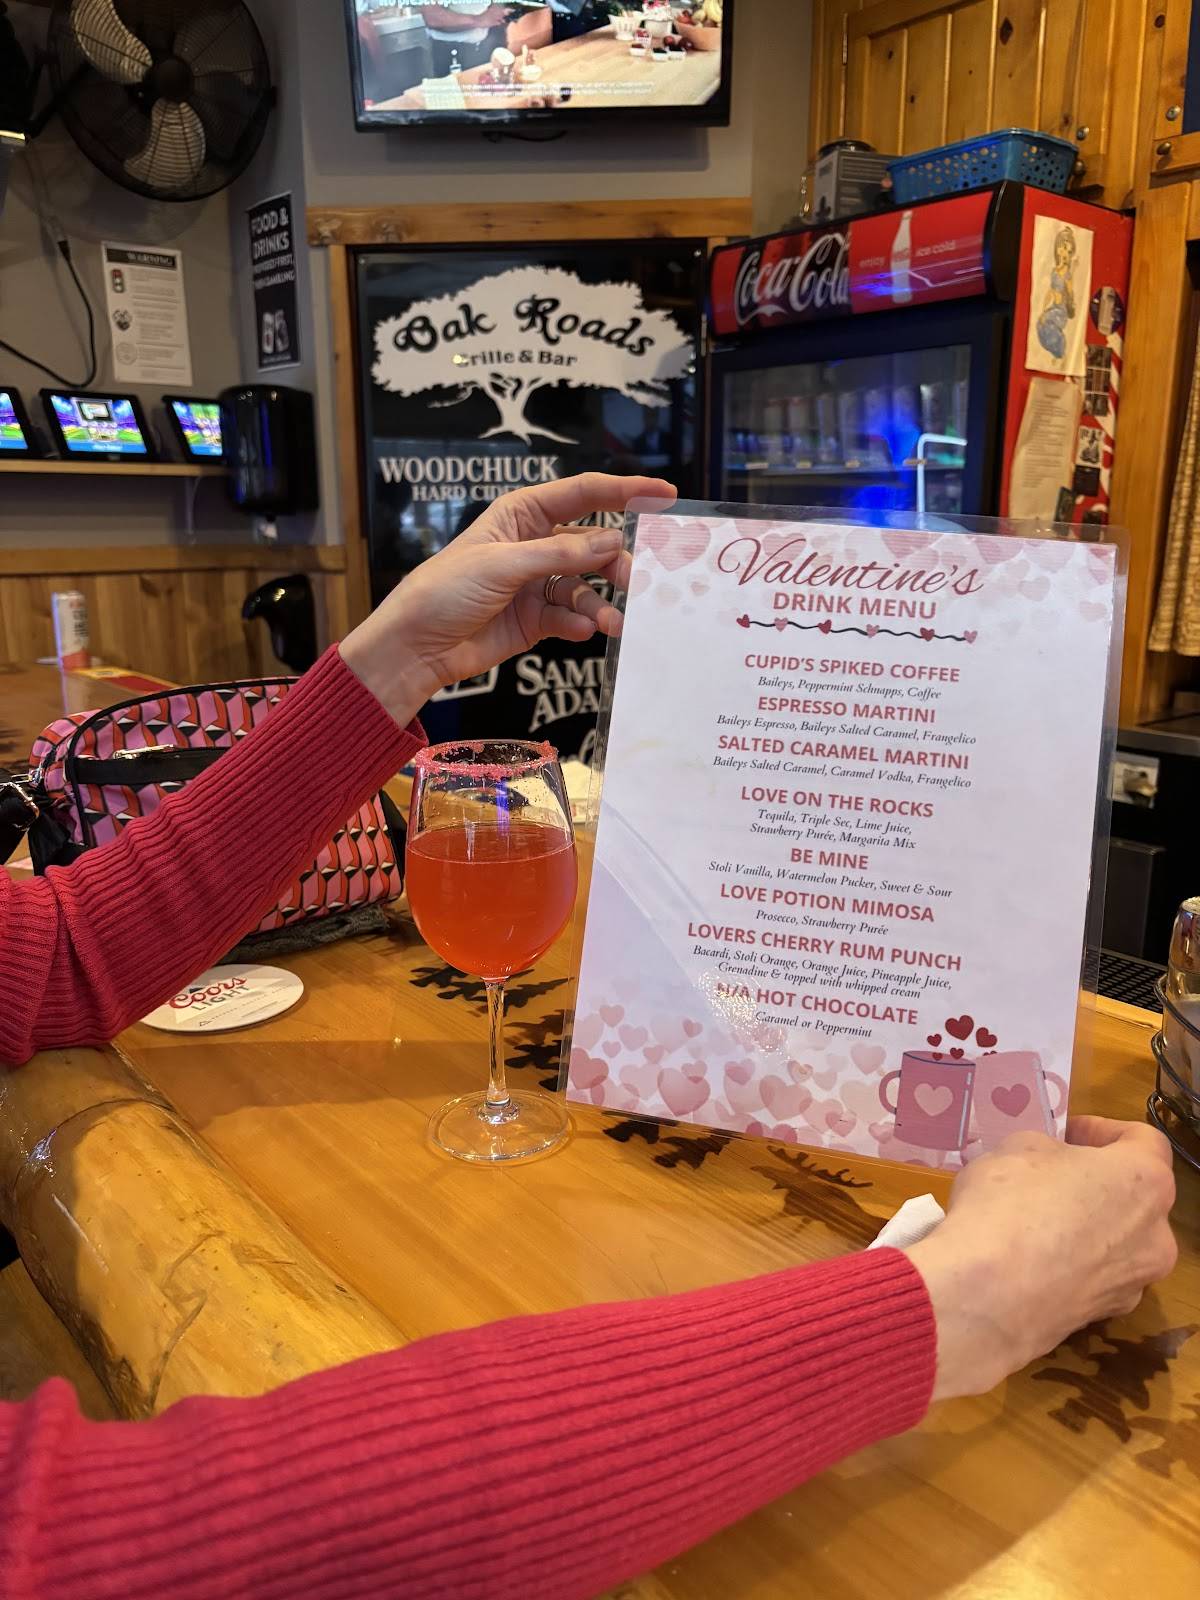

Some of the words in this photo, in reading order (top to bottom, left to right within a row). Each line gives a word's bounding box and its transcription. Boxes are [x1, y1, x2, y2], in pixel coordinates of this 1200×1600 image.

[251, 210, 278, 234] FOOD
[279, 207, 289, 226] &
[253, 231, 290, 259] DRINKS
[859, 256, 886, 269] enjoy
[932, 239, 956, 254] cold
[735, 232, 850, 326] Coca-Cola
[393, 303, 497, 352] Oak
[514, 294, 655, 356] Roads
[518, 349, 533, 364] &
[538, 350, 578, 367] Bar
[378, 456, 559, 484] WOODCHUCK
[411, 485, 467, 502] HARD
[470, 485, 522, 501] CID
[718, 538, 984, 595] Valentine's
[773, 592, 851, 614] DRINK
[859, 597, 936, 619] MENU
[745, 654, 814, 671] CUPID'S
[820, 659, 884, 676] SPIKED
[890, 664, 960, 682] COFFEE
[758, 676, 794, 690] Baileys,
[798, 679, 853, 695] Peppermint
[856, 682, 904, 697] Schnapps,
[908, 687, 941, 701] Coffee
[758, 697, 846, 715] ESPRESSO
[853, 703, 936, 723] MARTINI
[717, 715, 751, 729] Baileys
[754, 718, 797, 732] Espresso,
[801, 721, 836, 733] Baileys
[839, 724, 870, 736] Salted
[873, 726, 919, 742] Caramel,
[923, 731, 976, 745] Frangelico
[718, 735, 784, 753] SALTED
[790, 741, 879, 762] CARAMEL
[885, 748, 969, 770] MARTINI
[713, 756, 747, 770] Baileys
[750, 759, 780, 770] Salted
[783, 761, 828, 776] Caramel,
[831, 766, 873, 779] Caramel
[879, 770, 914, 784] Vodka,
[917, 773, 971, 788] Frangelico
[741, 786, 787, 803] LOVE
[793, 791, 822, 807] ON
[828, 794, 863, 811] THE
[869, 797, 934, 818] ROCKS
[750, 823, 803, 840] Strawberry
[806, 828, 836, 842] Purée,
[839, 831, 890, 846] Margarita
[893, 836, 916, 849] Mix
[758, 809, 797, 824] Tequila,
[801, 812, 831, 827] Triple
[833, 815, 852, 828] Sec,
[856, 818, 882, 831] Lime
[882, 821, 912, 835] Juice,
[791, 848, 813, 864] BE
[819, 850, 869, 870] MINE
[709, 861, 731, 873] Stoli
[735, 863, 773, 878] Vanilla,
[777, 868, 837, 885] Watermelon
[840, 876, 876, 890] Pucker,
[880, 880, 910, 893] Sweet
[913, 884, 924, 894] &
[927, 886, 952, 897] Sour
[720, 883, 766, 902] LOVE
[772, 889, 845, 912] POTION
[852, 899, 934, 922] MIMOSA
[756, 909, 798, 925] Prosecco,
[801, 915, 856, 934] Strawberry
[859, 922, 889, 936] Purée
[688, 922, 755, 944] LOVERS
[761, 932, 835, 954] CHERRY
[840, 942, 884, 961] RUM
[890, 948, 961, 971] PUNCH
[693, 945, 731, 960] Bacardi,
[734, 951, 757, 963] Stoli
[760, 953, 799, 970] Orange,
[802, 960, 839, 975] Orange
[840, 964, 868, 979] Juice,
[871, 968, 921, 988] Pineapple
[922, 975, 952, 990] Juice,
[718, 961, 769, 979] Grenadine
[771, 970, 781, 979] &
[784, 970, 816, 985] topped
[819, 975, 842, 988] with
[845, 979, 888, 995] whipped
[890, 985, 921, 998] cream
[167, 977, 247, 1009] Coors
[191, 985, 251, 1010] LIGHT
[756, 989, 797, 1006] HOT
[801, 996, 918, 1025] CHOCOLATE
[755, 1011, 798, 1027] Caramel
[801, 1020, 811, 1028] or
[814, 1021, 872, 1038] Peppermint
